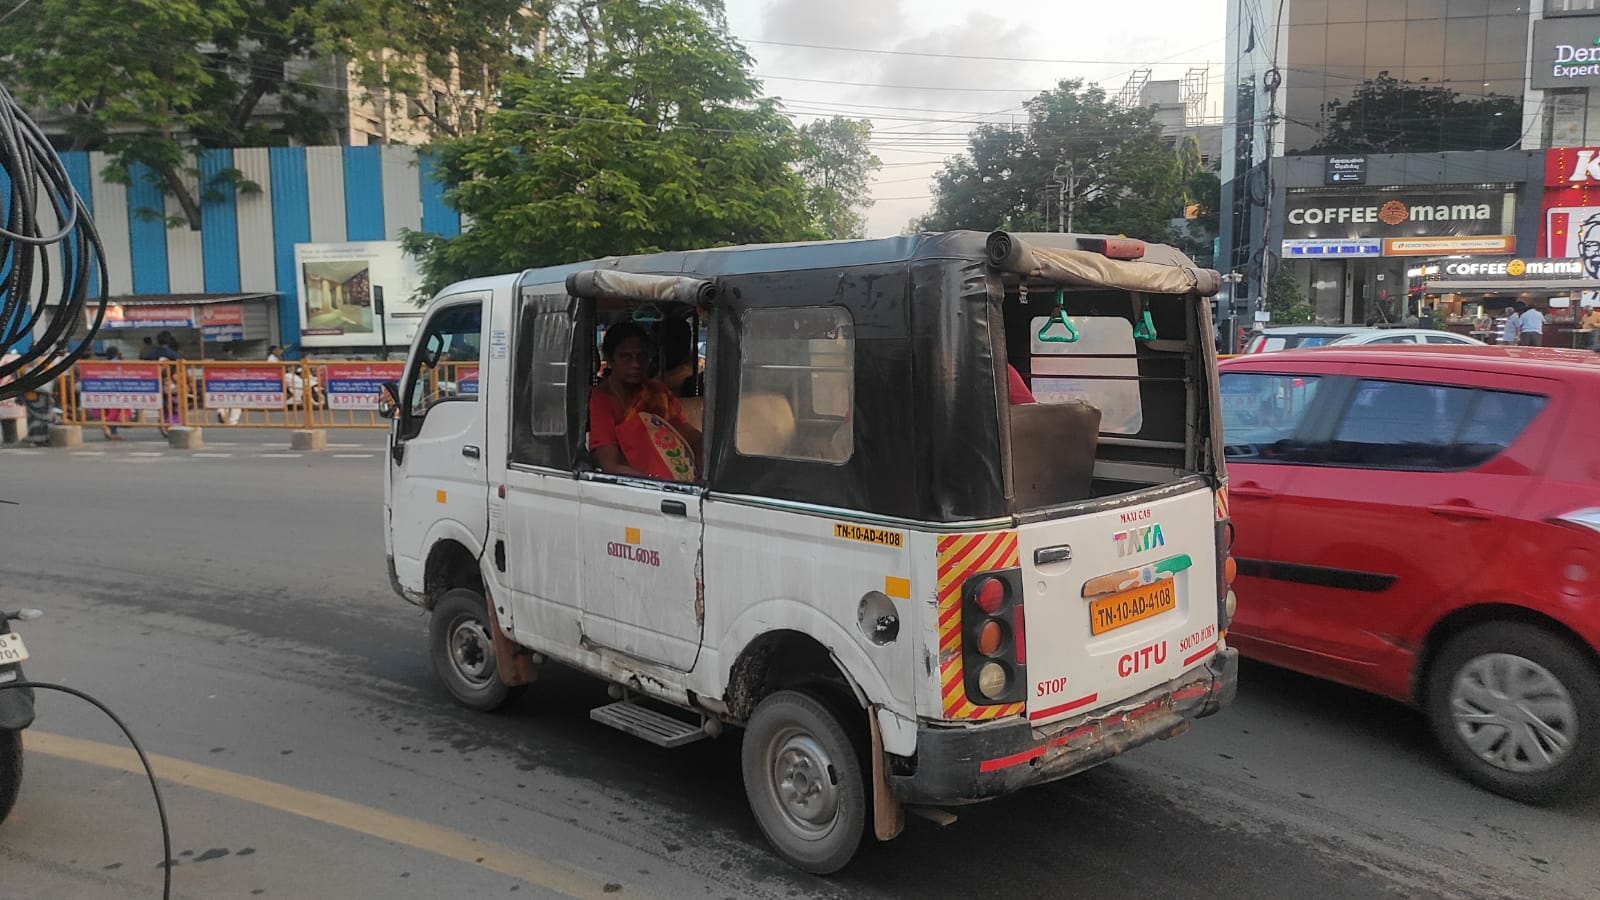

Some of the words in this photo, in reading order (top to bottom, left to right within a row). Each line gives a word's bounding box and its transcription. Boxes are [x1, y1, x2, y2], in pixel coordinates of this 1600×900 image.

[1288, 207, 1378, 225] COFFEE
[1409, 203, 1491, 222] mama
[1446, 263, 1507, 275] COFFEE
[1526, 261, 1582, 275] mama
[332, 395, 379, 404] ADITYA
[1120, 511, 1137, 524] MAXI
[1138, 508, 1151, 520] CAB
[836, 524, 901, 547] TN-10-AD-4108
[1113, 523, 1166, 558] TATA
[607, 541, 660, 567] வாடகை
[1098, 588, 1171, 628] TN-10-AD-4108
[1179, 632, 1200, 652] SOUND
[1200, 624, 1215, 641] HORN
[1117, 641, 1167, 678] CITU
[1037, 677, 1067, 697] STOP
